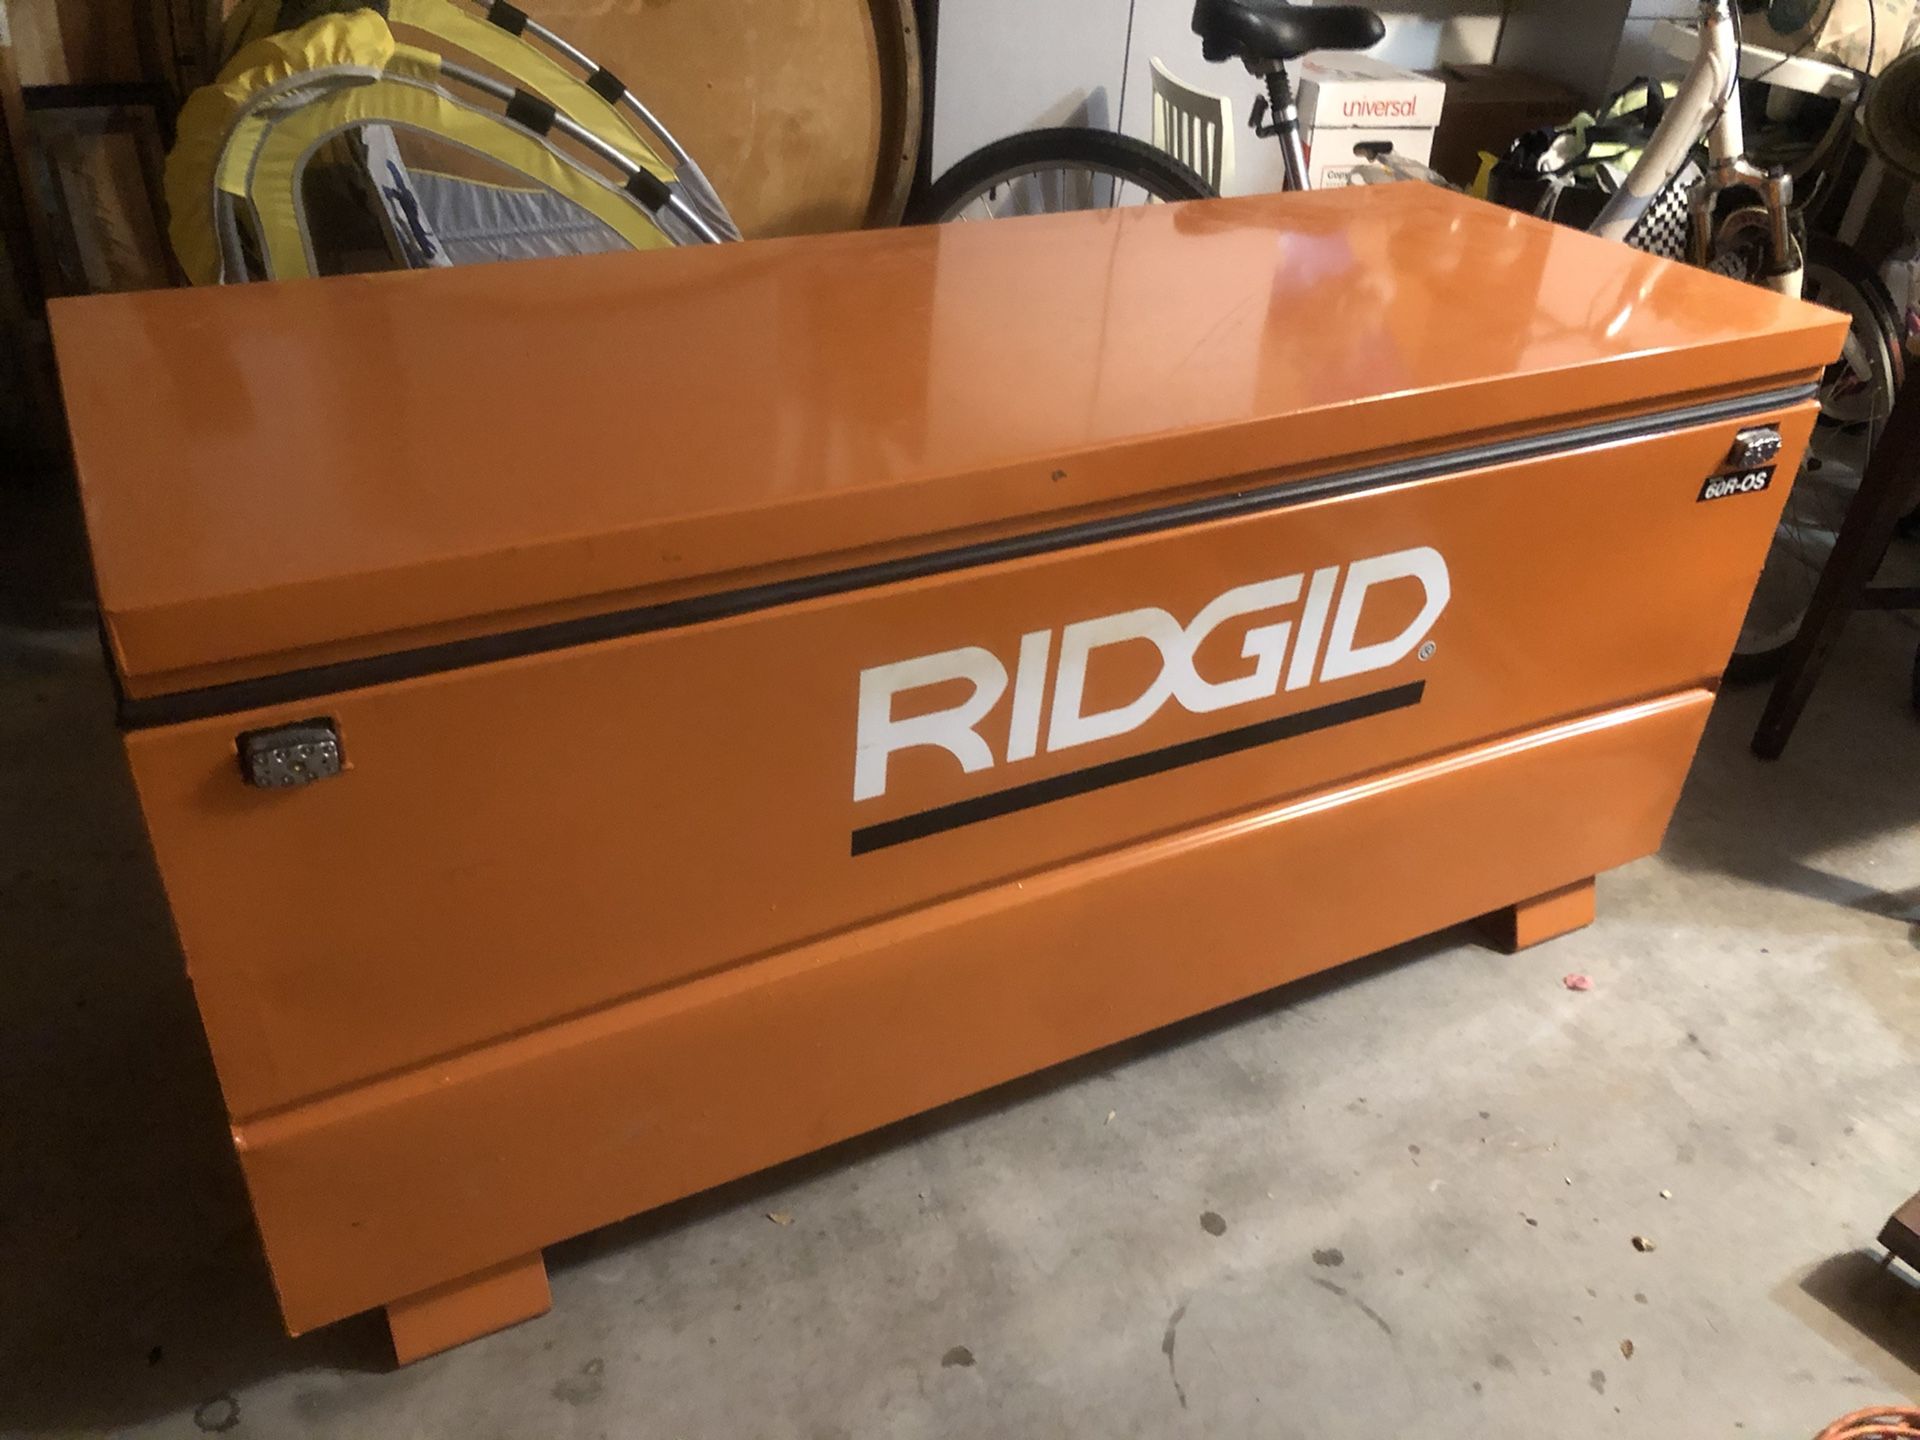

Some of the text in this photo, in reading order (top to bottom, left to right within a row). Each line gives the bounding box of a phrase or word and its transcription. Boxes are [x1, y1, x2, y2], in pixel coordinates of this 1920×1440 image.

[1342, 94, 1417, 118] universal
[1704, 471, 1767, 500] 60R-OS
[853, 546, 1451, 802] RIDGID
